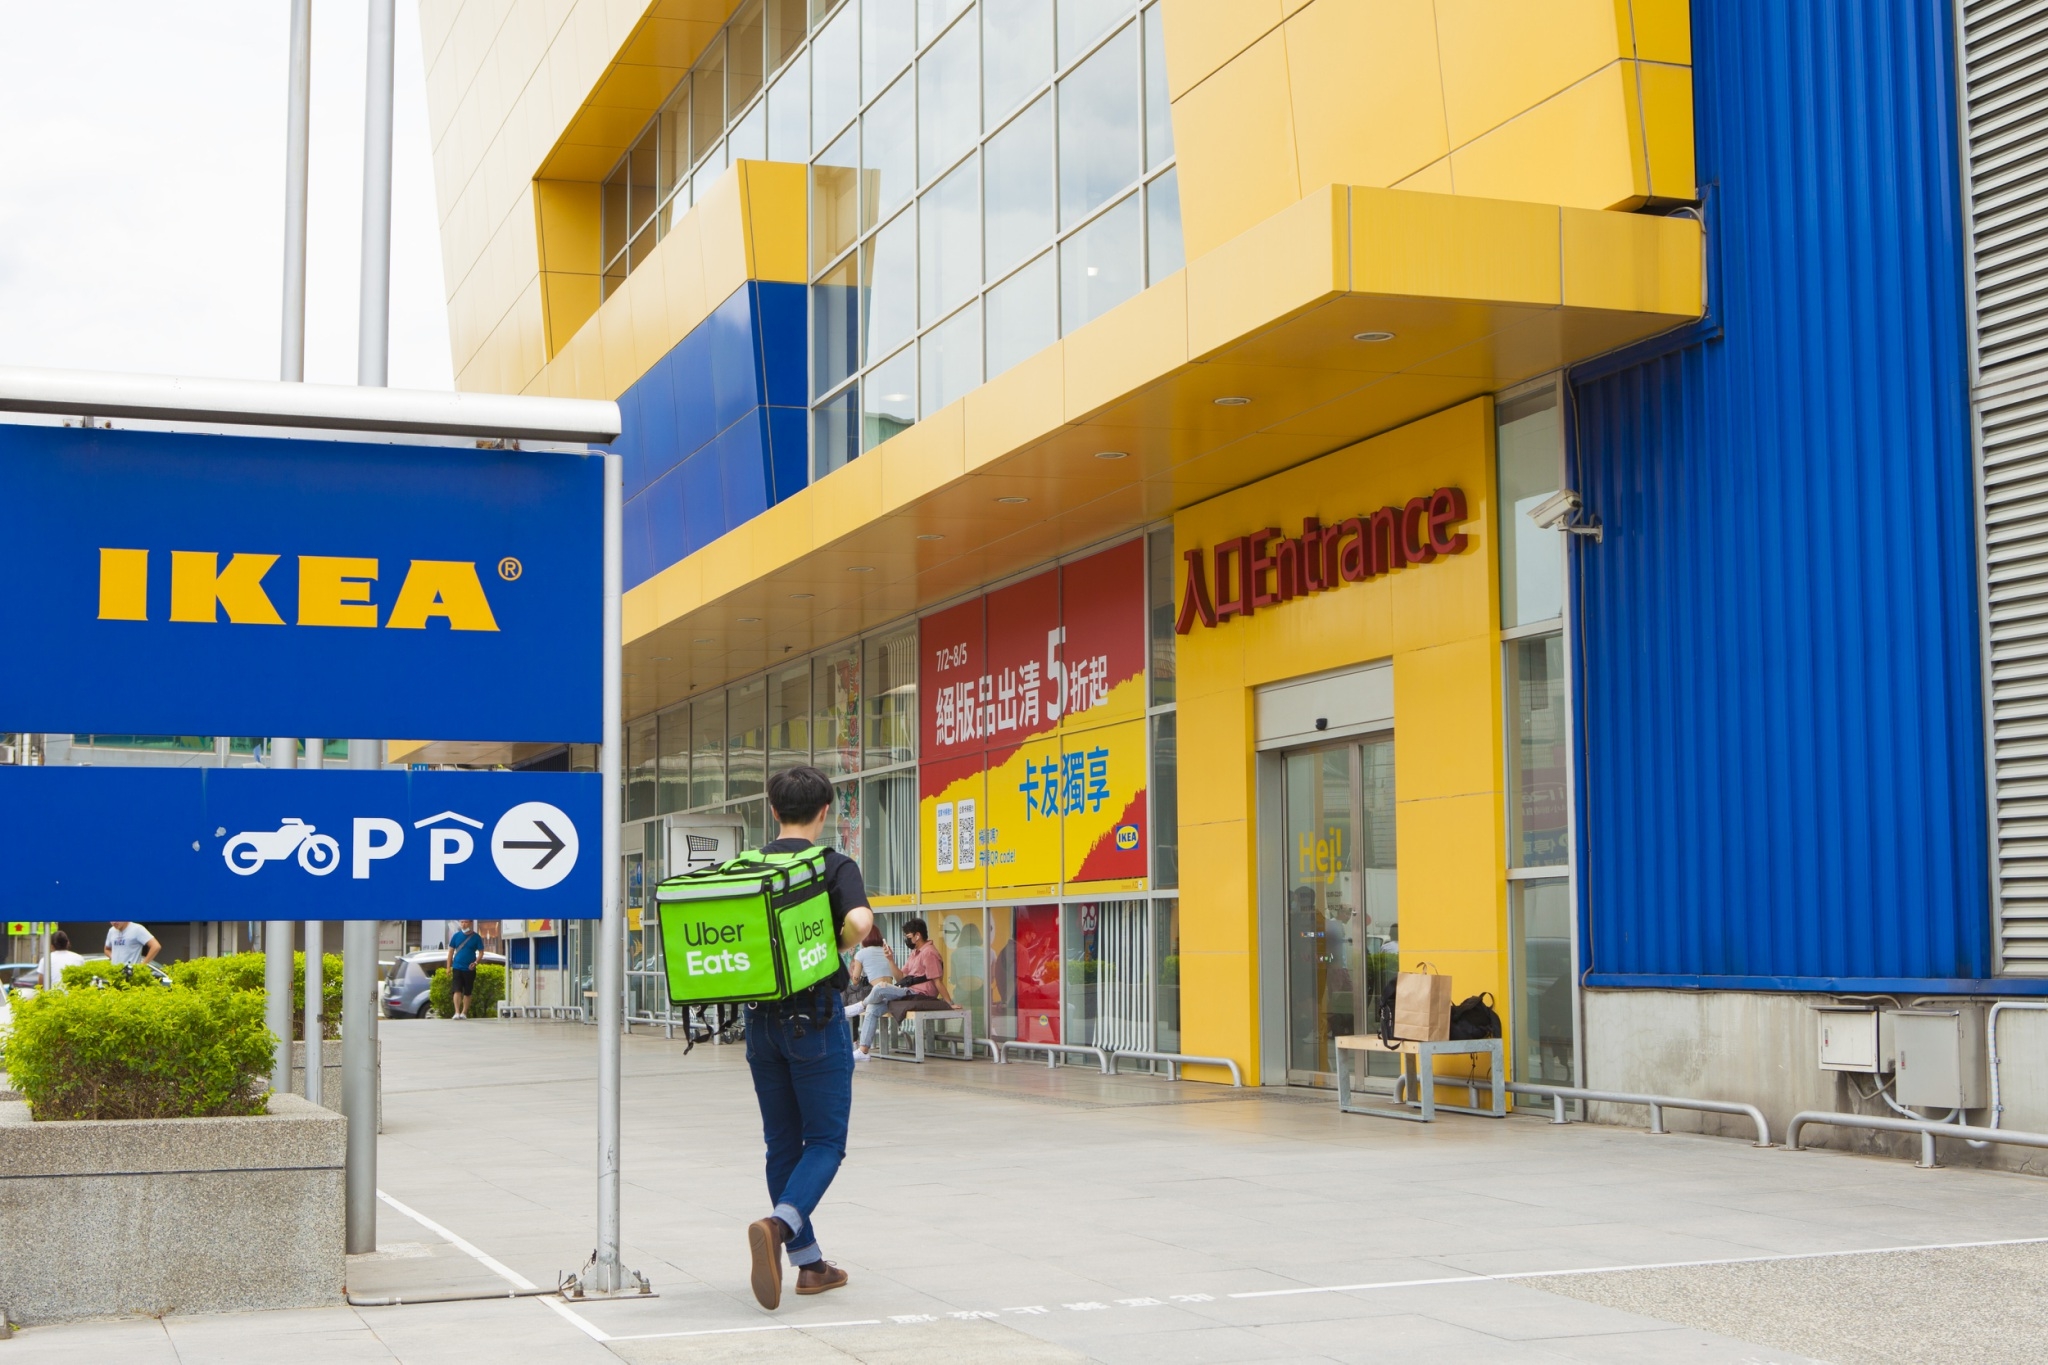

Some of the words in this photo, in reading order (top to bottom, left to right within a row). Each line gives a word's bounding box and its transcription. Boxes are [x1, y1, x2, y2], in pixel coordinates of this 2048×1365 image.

[1175, 535, 1254, 635] 入口
[1250, 487, 1469, 608] Entrance
[1018, 744, 1110, 822] 卡友獨享
[351, 817, 405, 880] P
[429, 828, 475, 882] P
[1118, 831, 1137, 843] IKEA
[1298, 826, 1343, 885] Hej!
[684, 921, 745, 947] Uber
[794, 917, 825, 946] Uber
[686, 949, 751, 977] Eats
[798, 942, 828, 972] Eats
